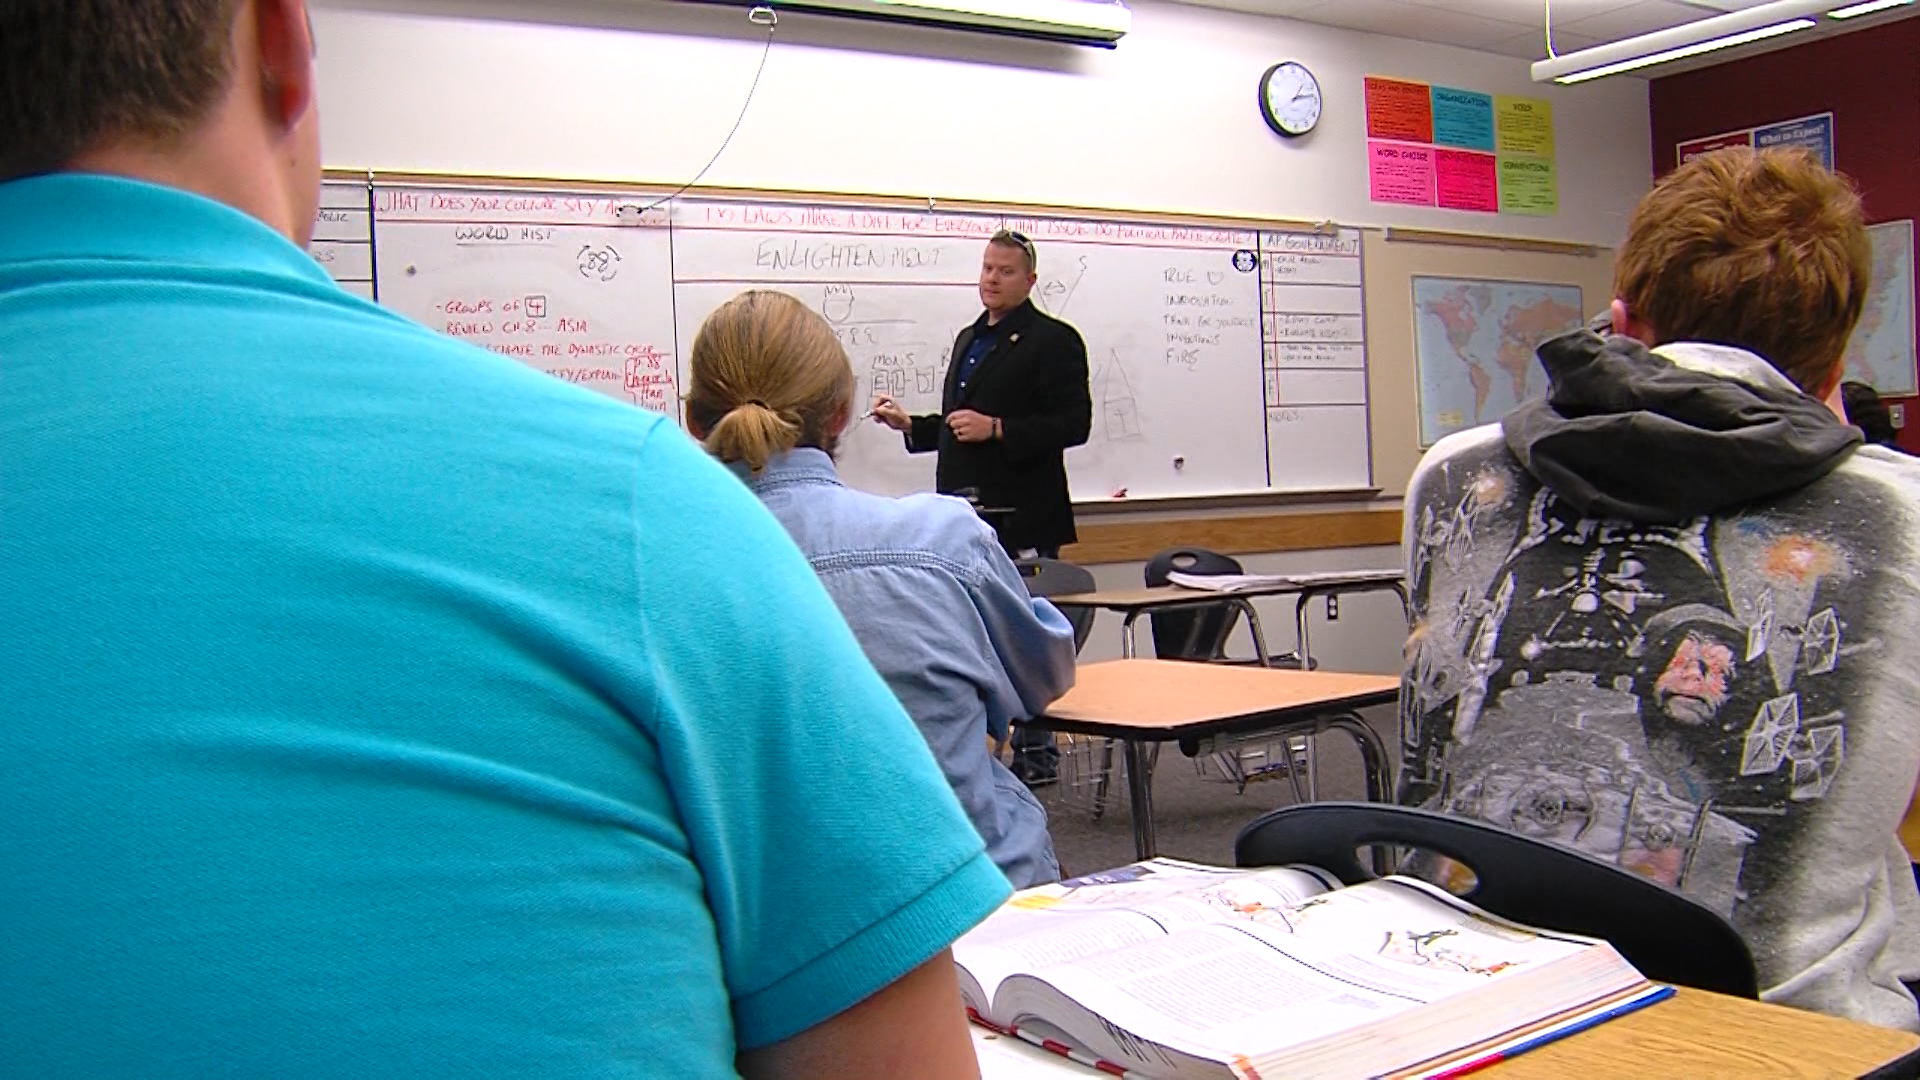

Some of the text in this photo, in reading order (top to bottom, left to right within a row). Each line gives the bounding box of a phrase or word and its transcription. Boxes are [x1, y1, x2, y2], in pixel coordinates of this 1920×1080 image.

[1376, 149, 1398, 158] WORD
[430, 193, 465, 210] DOES
[455, 226, 509, 240] WORLD
[557, 318, 587, 334] ASIA
